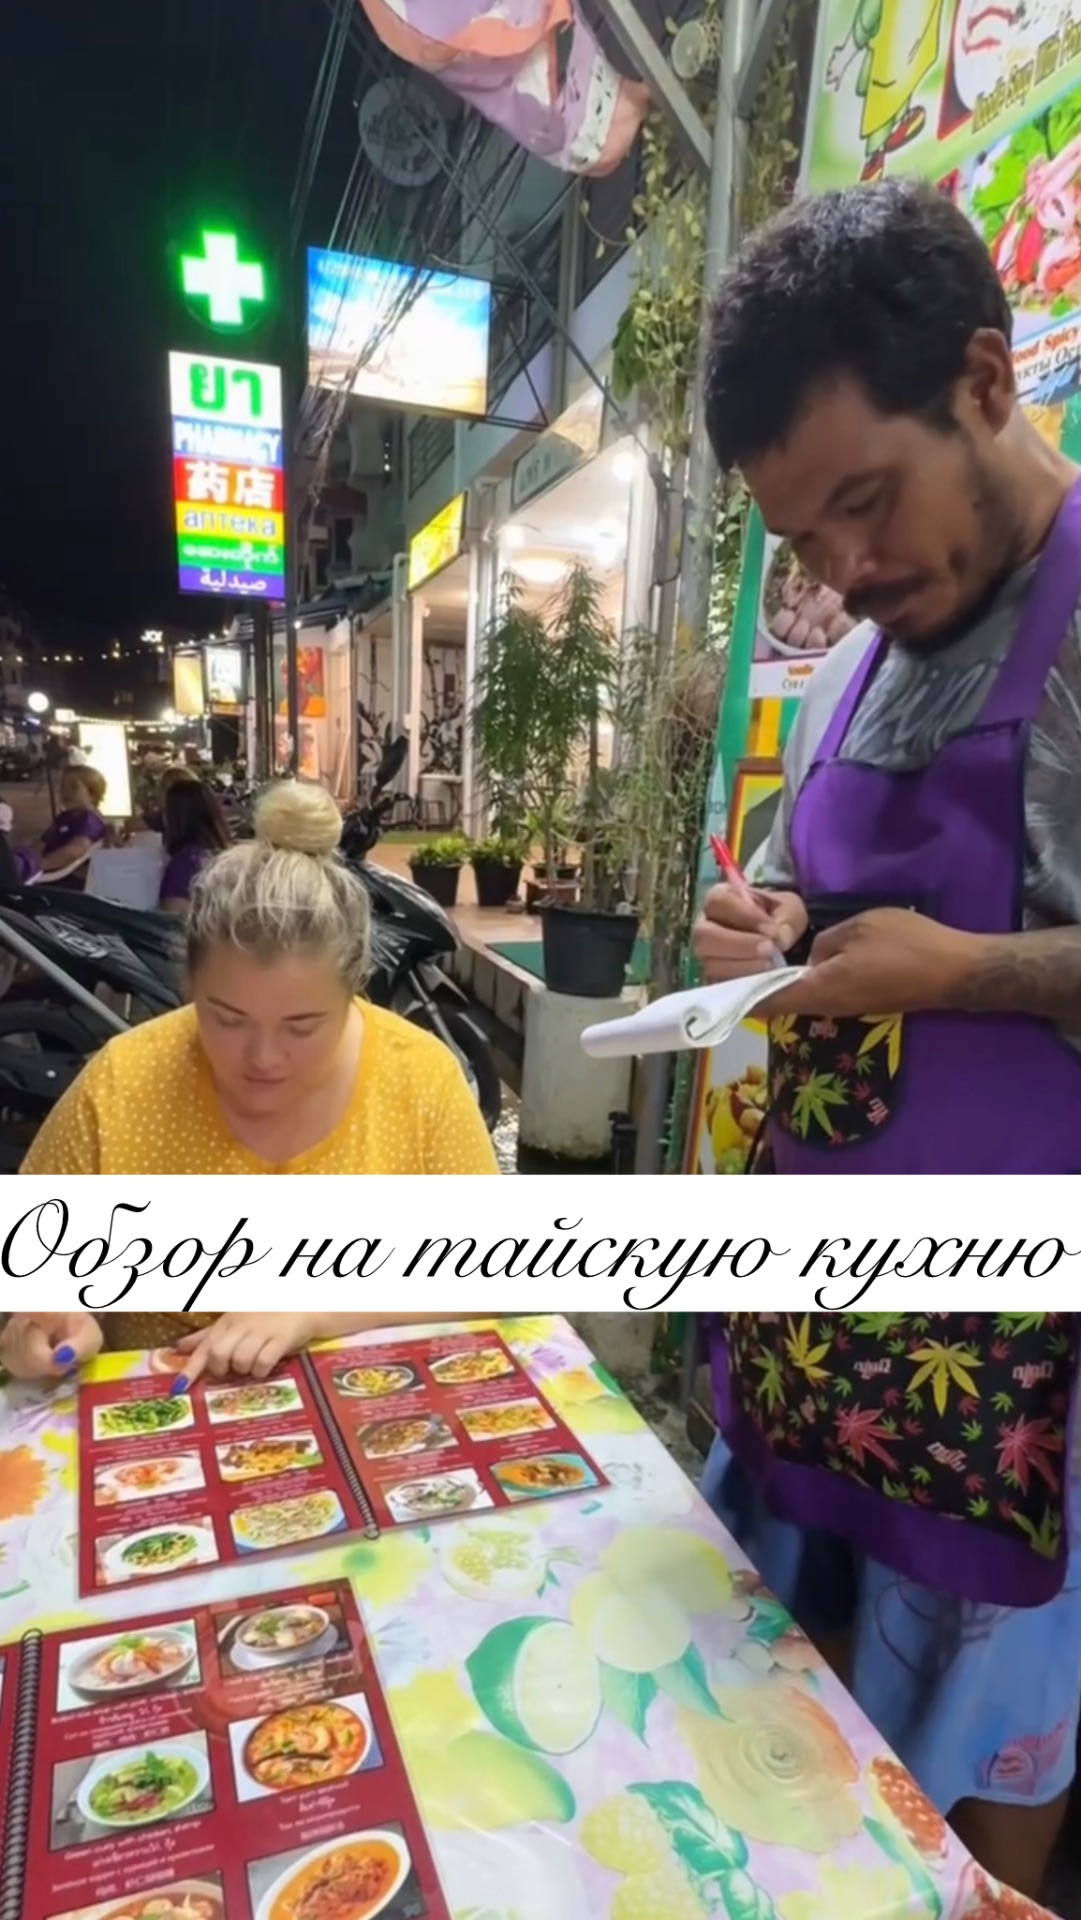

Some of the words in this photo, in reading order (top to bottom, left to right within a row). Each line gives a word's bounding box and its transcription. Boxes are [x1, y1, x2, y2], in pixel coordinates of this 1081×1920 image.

[1045, 327, 1079, 352] Spicy
[190, 363, 262, 416] ยา
[174, 420, 281, 464] PHARMACY
[185, 462, 275, 509] 药店
[184, 510, 276, 537] аптека
[200, 567, 267, 595] صيدلية
